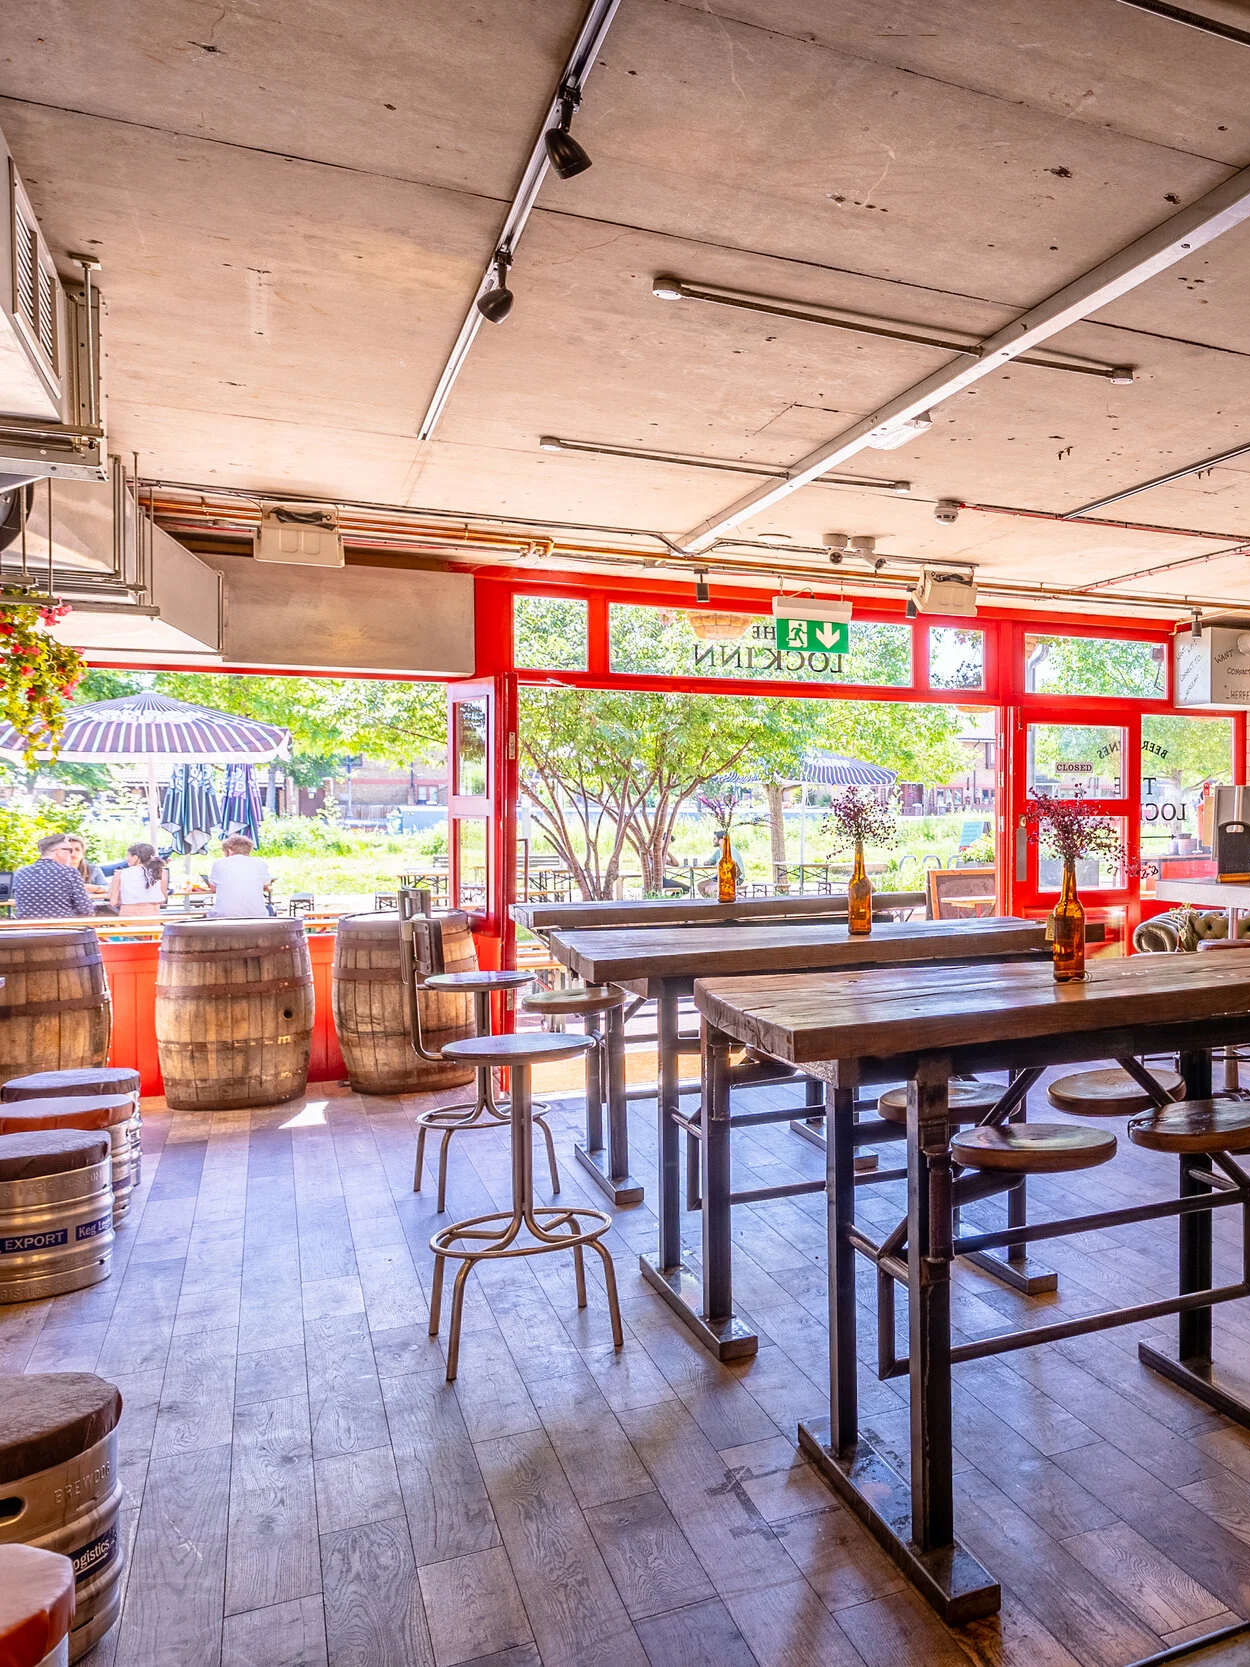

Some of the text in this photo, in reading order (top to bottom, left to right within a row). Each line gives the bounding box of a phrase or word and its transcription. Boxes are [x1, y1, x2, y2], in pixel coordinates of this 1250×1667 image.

[1214, 648, 1234, 664] WANT
[1056, 763, 1093, 773] CLOSED
[4, 1231, 65, 1251] EXPORT
[78, 1225, 97, 1239] Keg
[54, 1461, 111, 1504] BREWDOG
[73, 1538, 111, 1571] ogistics
